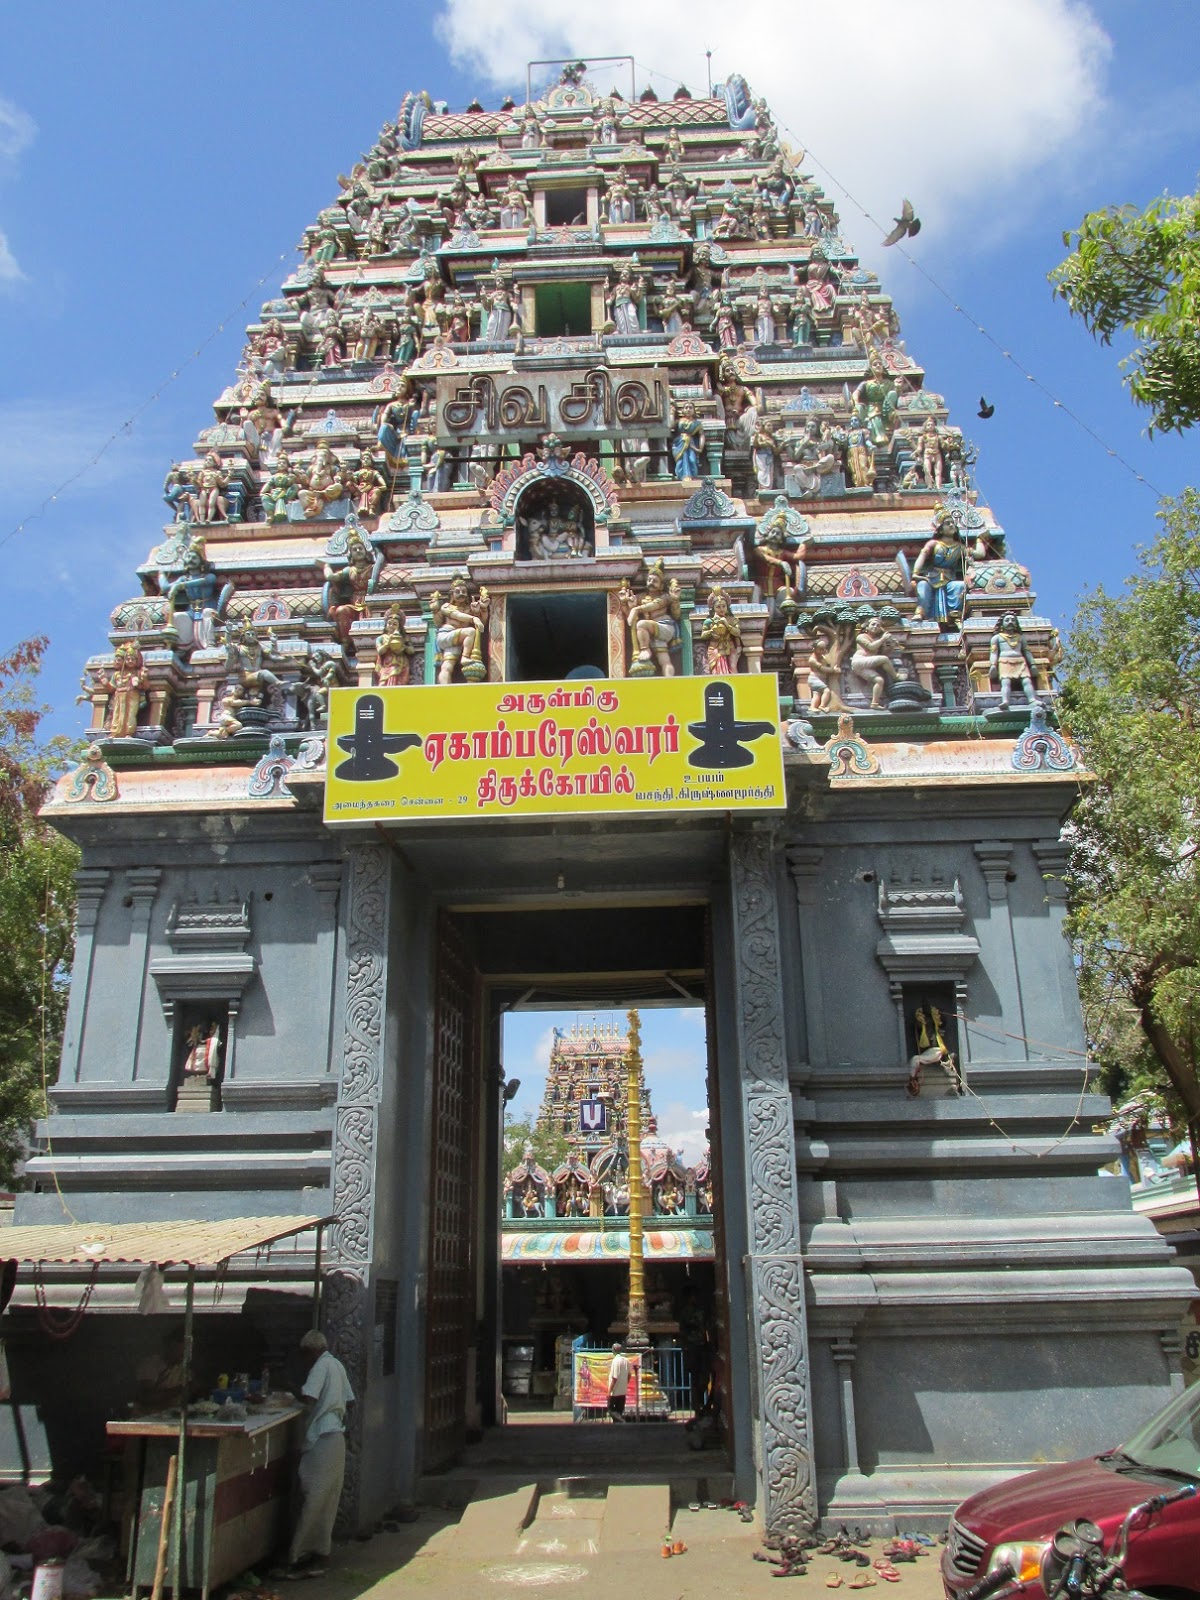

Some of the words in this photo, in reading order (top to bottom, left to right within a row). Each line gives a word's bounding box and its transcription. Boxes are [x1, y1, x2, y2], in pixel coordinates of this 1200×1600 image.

[443, 374, 547, 430] சிவ
[559, 369, 663, 424] சிவ
[497, 686, 619, 714] அருள்மிகு
[422, 714, 680, 772] ஏகாம்பரேஸ்வரர்
[477, 765, 635, 807] திருக்கோயில்
[683, 771, 725, 783] உபயம்
[457, 795, 468, 804] 29
